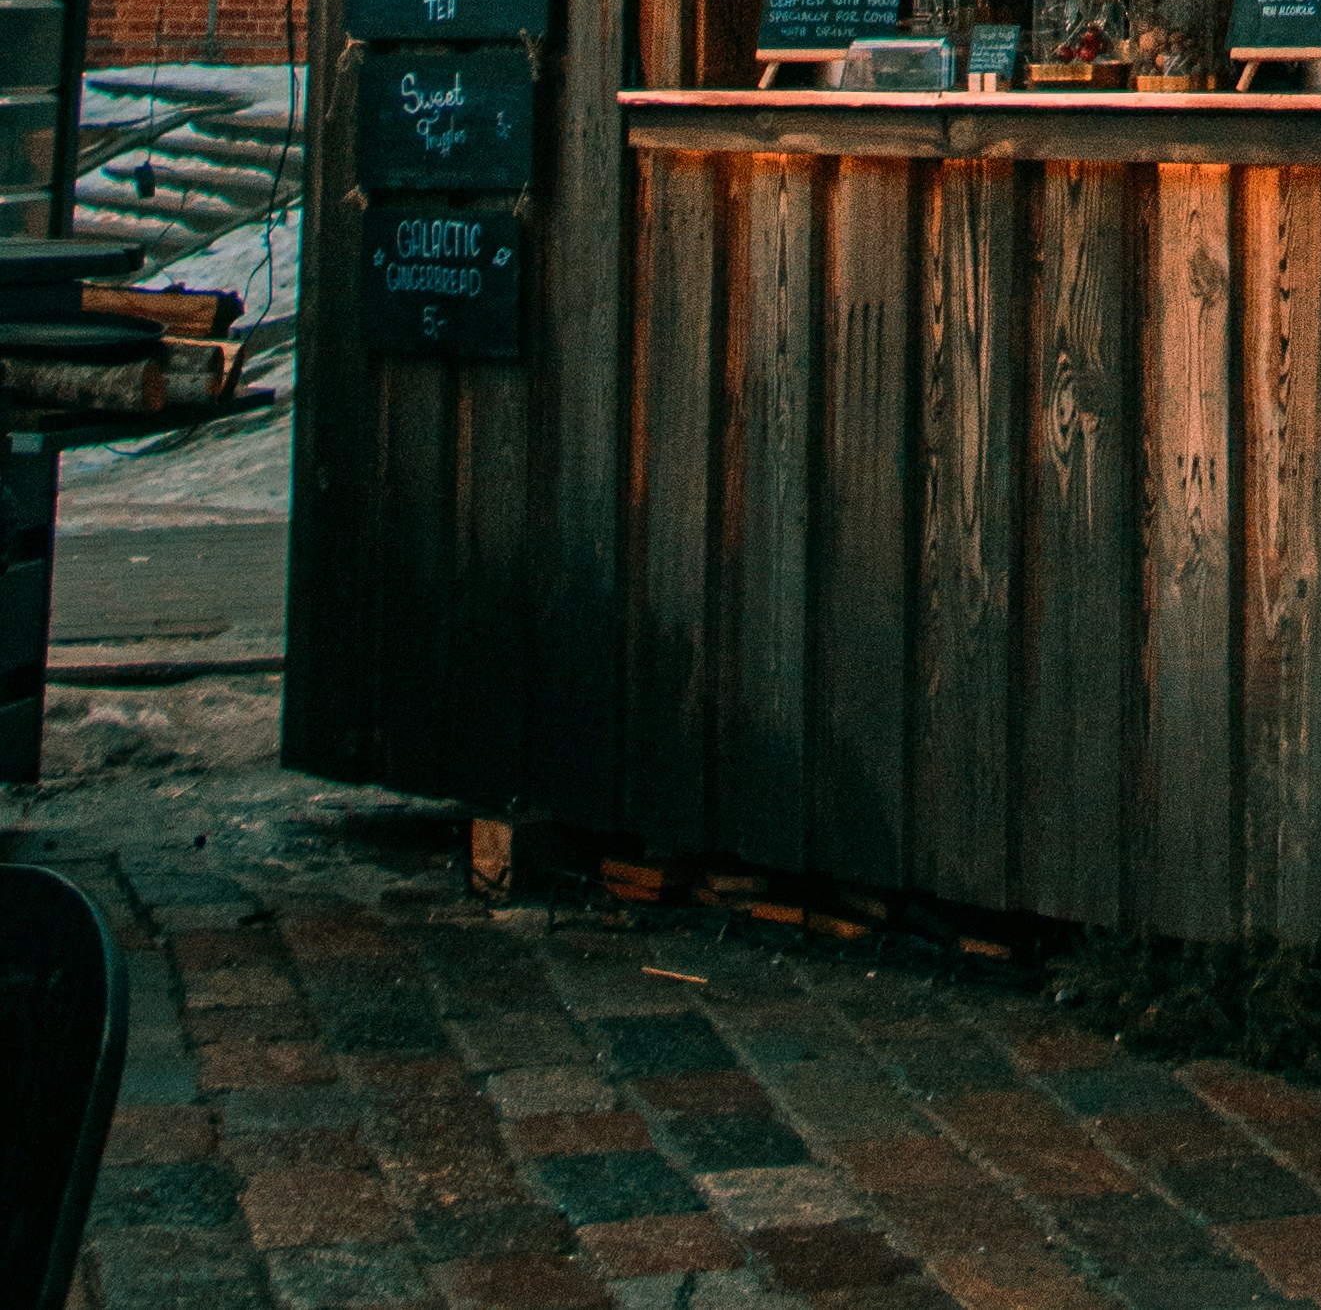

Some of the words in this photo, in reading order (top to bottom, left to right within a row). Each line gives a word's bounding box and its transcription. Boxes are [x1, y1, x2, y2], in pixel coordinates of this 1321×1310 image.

[836, 10, 860, 23] FOR
[401, 72, 464, 114] Sweet
[397, 219, 481, 258] GALACTIC
[386, 261, 481, 297] GINGERBREAD
